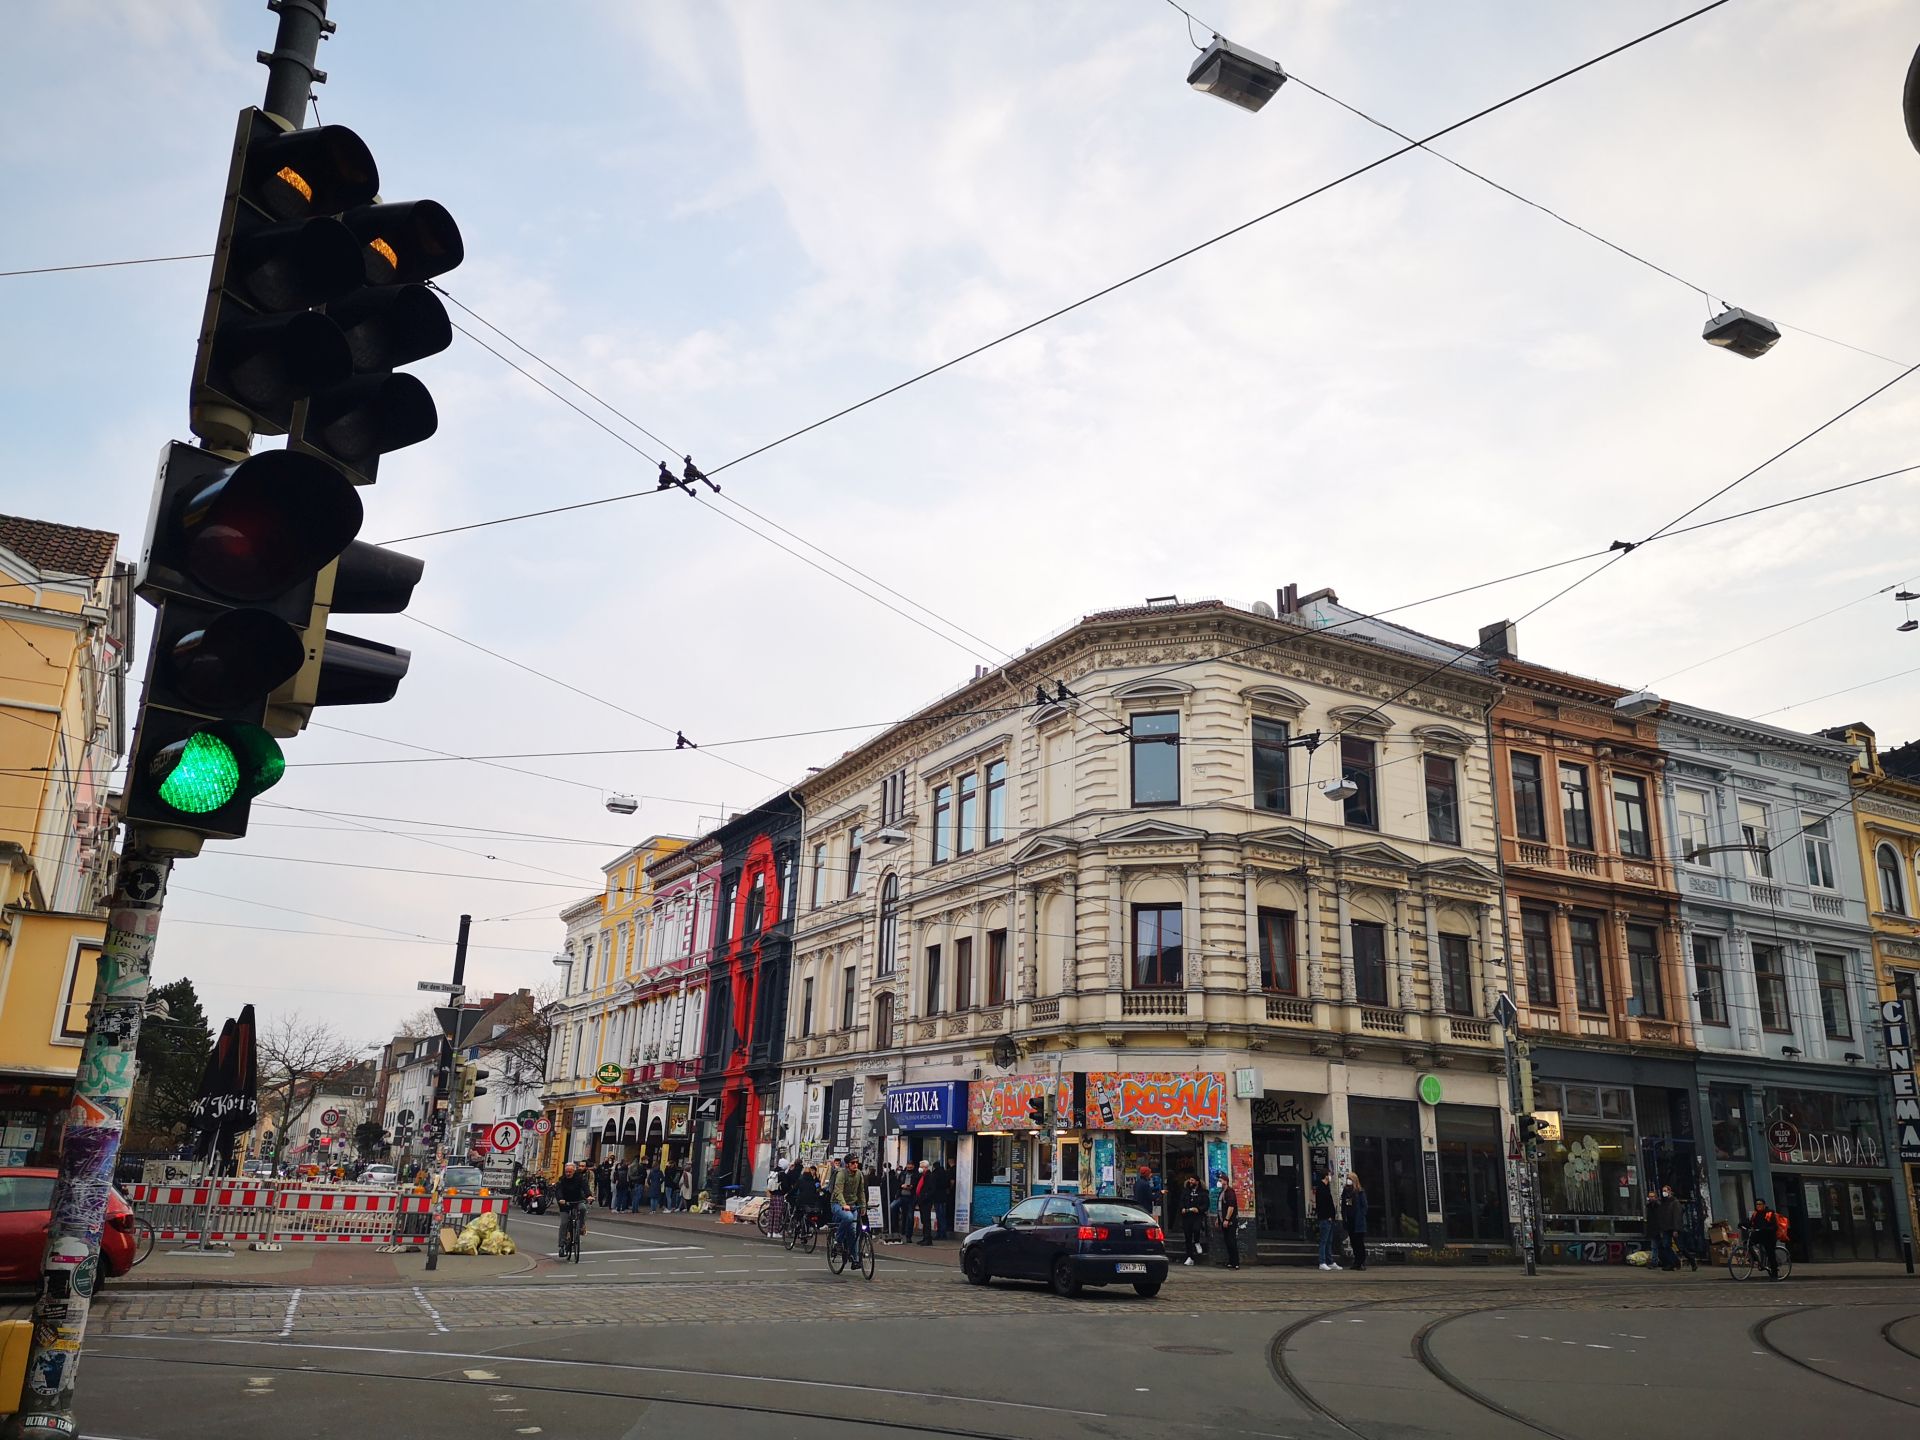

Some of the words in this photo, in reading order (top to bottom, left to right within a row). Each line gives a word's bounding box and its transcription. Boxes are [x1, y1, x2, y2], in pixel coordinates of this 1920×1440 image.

[889, 1090, 939, 1113] TAVERNA
[325, 1113, 336, 1122] 30
[538, 1122, 548, 1130] 30
[25, 1416, 48, 1426] ULTRA
[57, 1419, 73, 1433] TEAM
